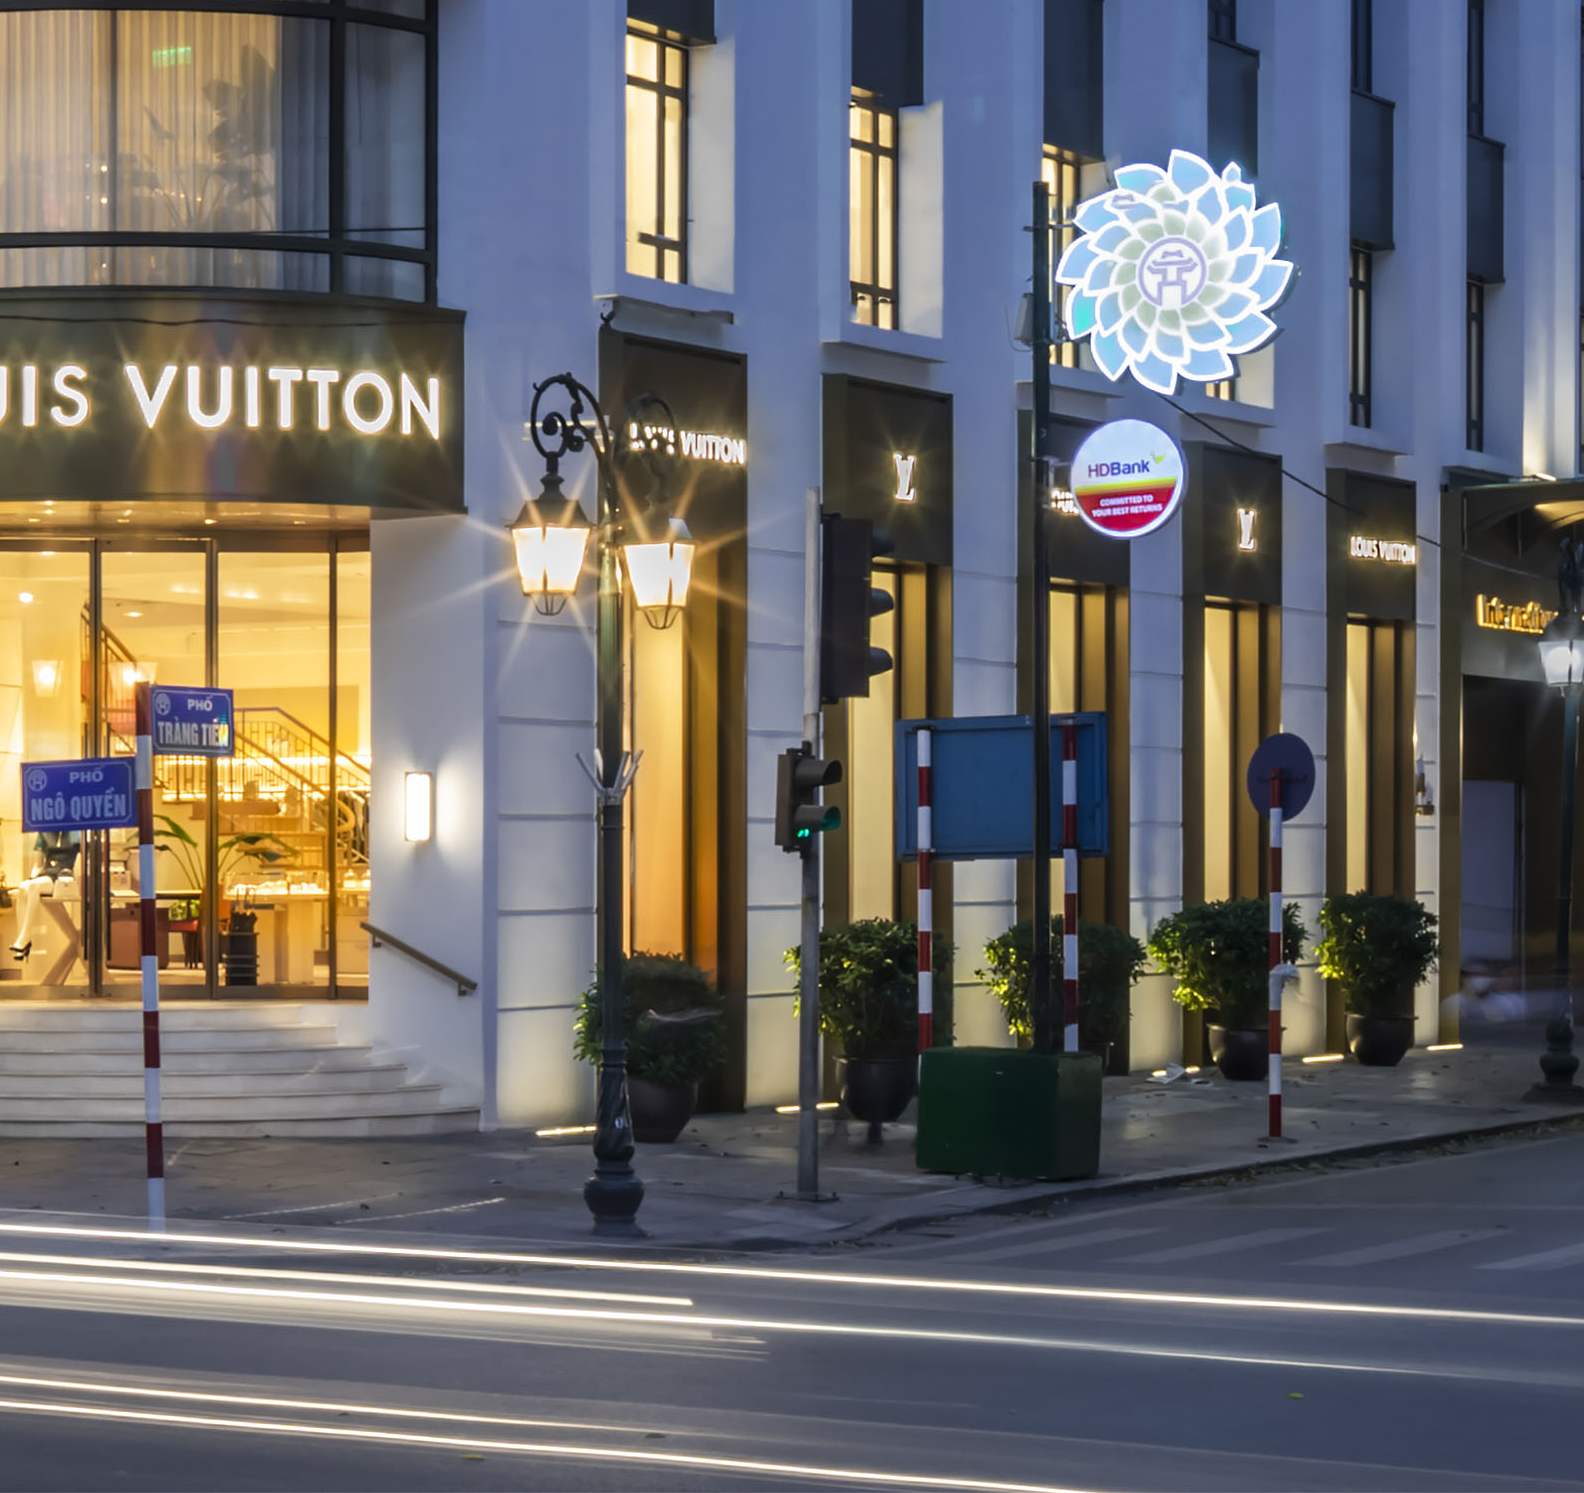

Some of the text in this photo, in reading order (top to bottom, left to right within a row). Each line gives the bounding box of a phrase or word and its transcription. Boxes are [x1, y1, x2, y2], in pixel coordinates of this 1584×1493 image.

[124, 364, 441, 441] VUITTON
[680, 429, 746, 465] VUITTON
[1087, 459, 1151, 479] HDBank
[1099, 495, 1143, 507] COMMITTED
[1350, 535, 1378, 558] LOUIS
[31, 791, 66, 821] NGÔ
